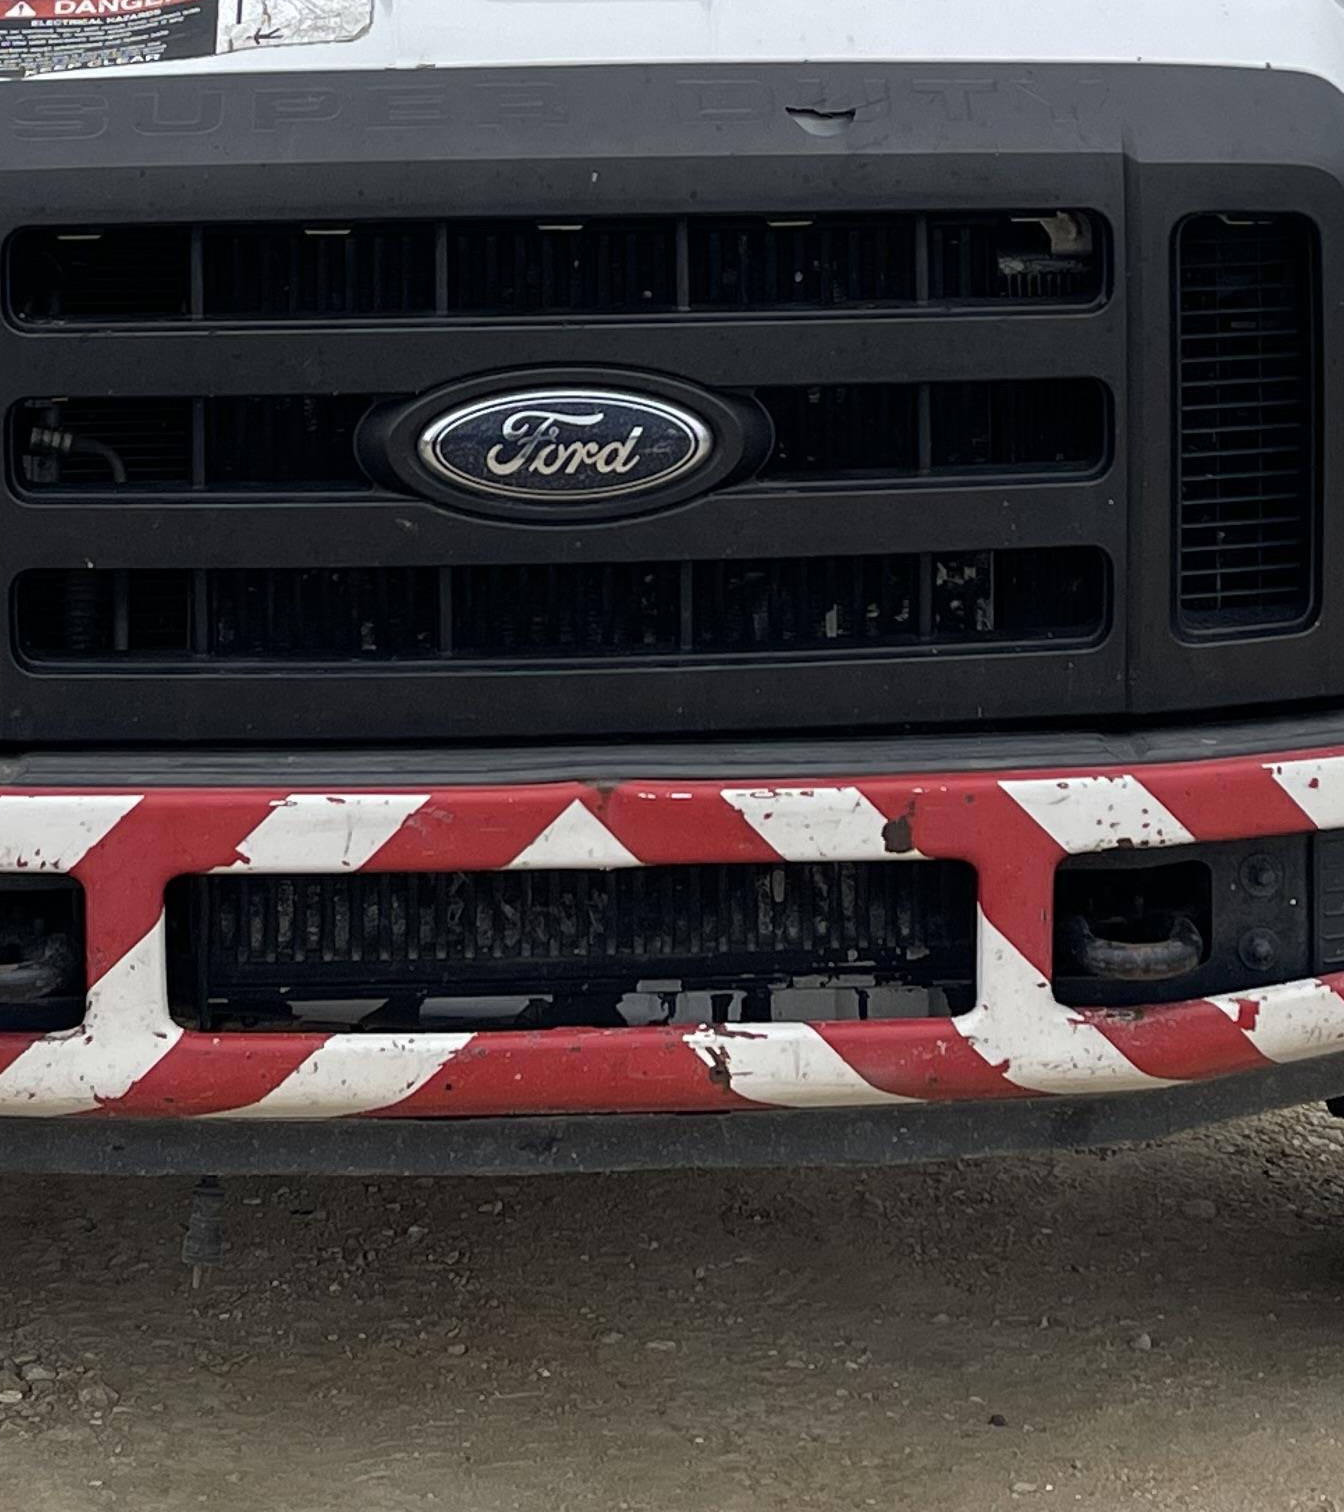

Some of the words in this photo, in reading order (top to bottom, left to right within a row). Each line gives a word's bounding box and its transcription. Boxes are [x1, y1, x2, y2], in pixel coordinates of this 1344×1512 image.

[31, 16, 103, 27] ELECTRICAL
[106, 9, 162, 25] HAZARDS
[10, 81, 569, 141] SUPER
[486, 410, 644, 475] Ford
